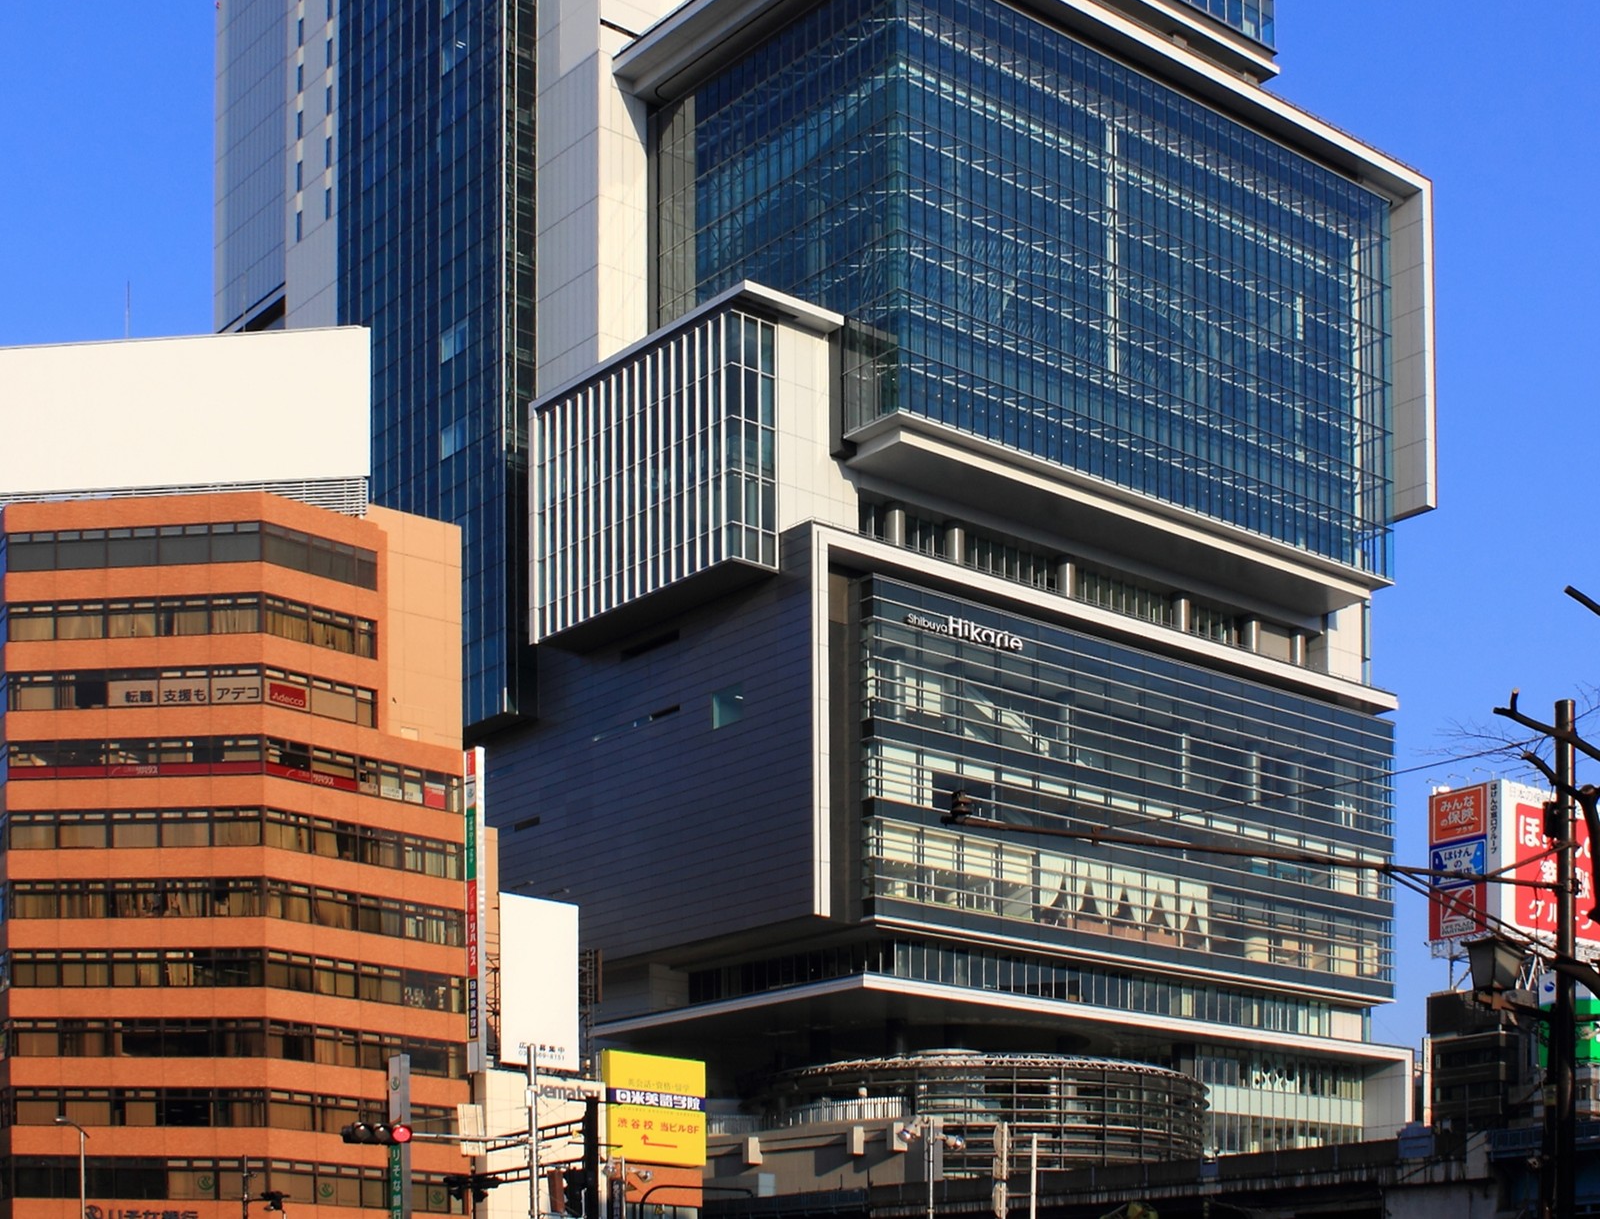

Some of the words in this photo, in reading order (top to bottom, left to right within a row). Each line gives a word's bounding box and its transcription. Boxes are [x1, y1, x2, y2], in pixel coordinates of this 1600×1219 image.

[907, 613, 948, 633] Shibuya
[948, 615, 1023, 651] Hikarie
[272, 691, 305, 708] Adecco
[1440, 795, 1474, 813] みんな
[1444, 848, 1472, 861] ほけん
[1453, 860, 1463, 869] の
[518, 1042, 566, 1054] 広募集中
[615, 1088, 700, 1111] 日米英語学院
[617, 1117, 654, 1131] 渋谷校
